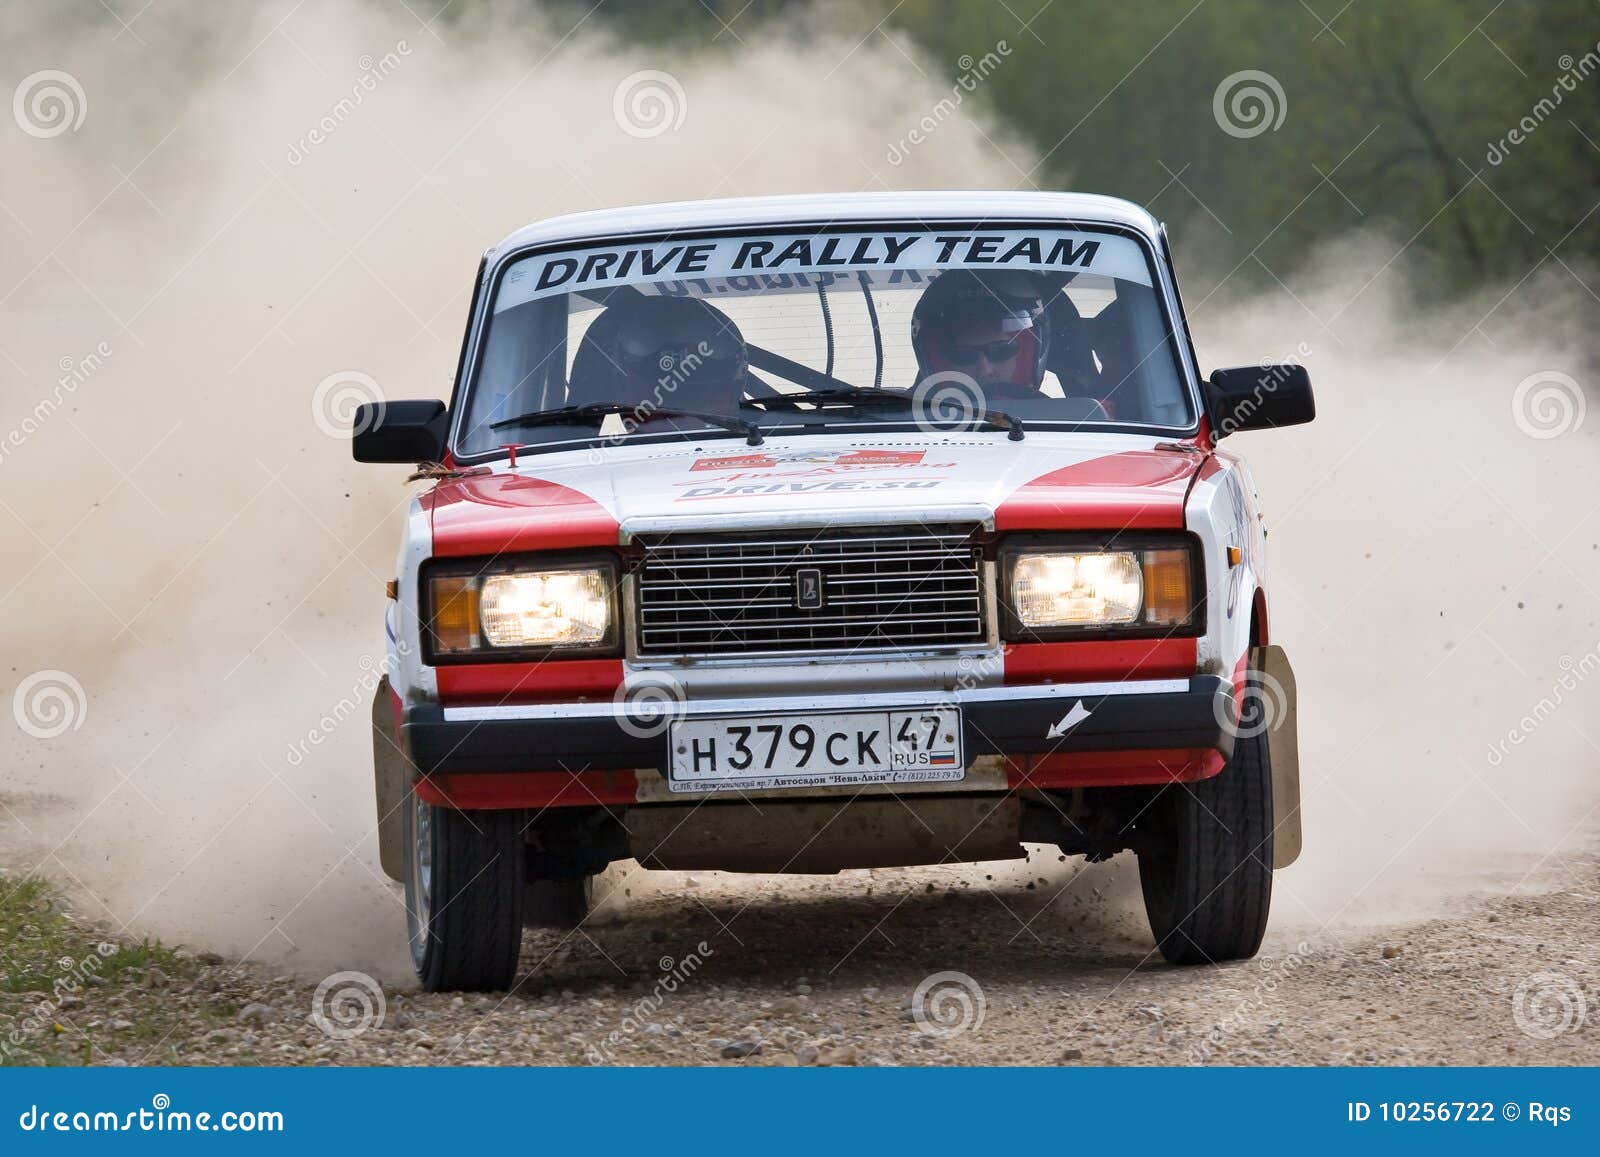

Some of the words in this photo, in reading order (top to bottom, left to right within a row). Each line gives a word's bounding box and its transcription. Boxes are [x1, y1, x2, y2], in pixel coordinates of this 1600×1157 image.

[534, 243, 717, 292] DRIVE
[731, 236, 922, 270] RALLY
[934, 236, 1101, 268] TEAM
[680, 480, 944, 498] DRIVE.su
[896, 716, 941, 750] 47
[895, 752, 928, 765] RUS
